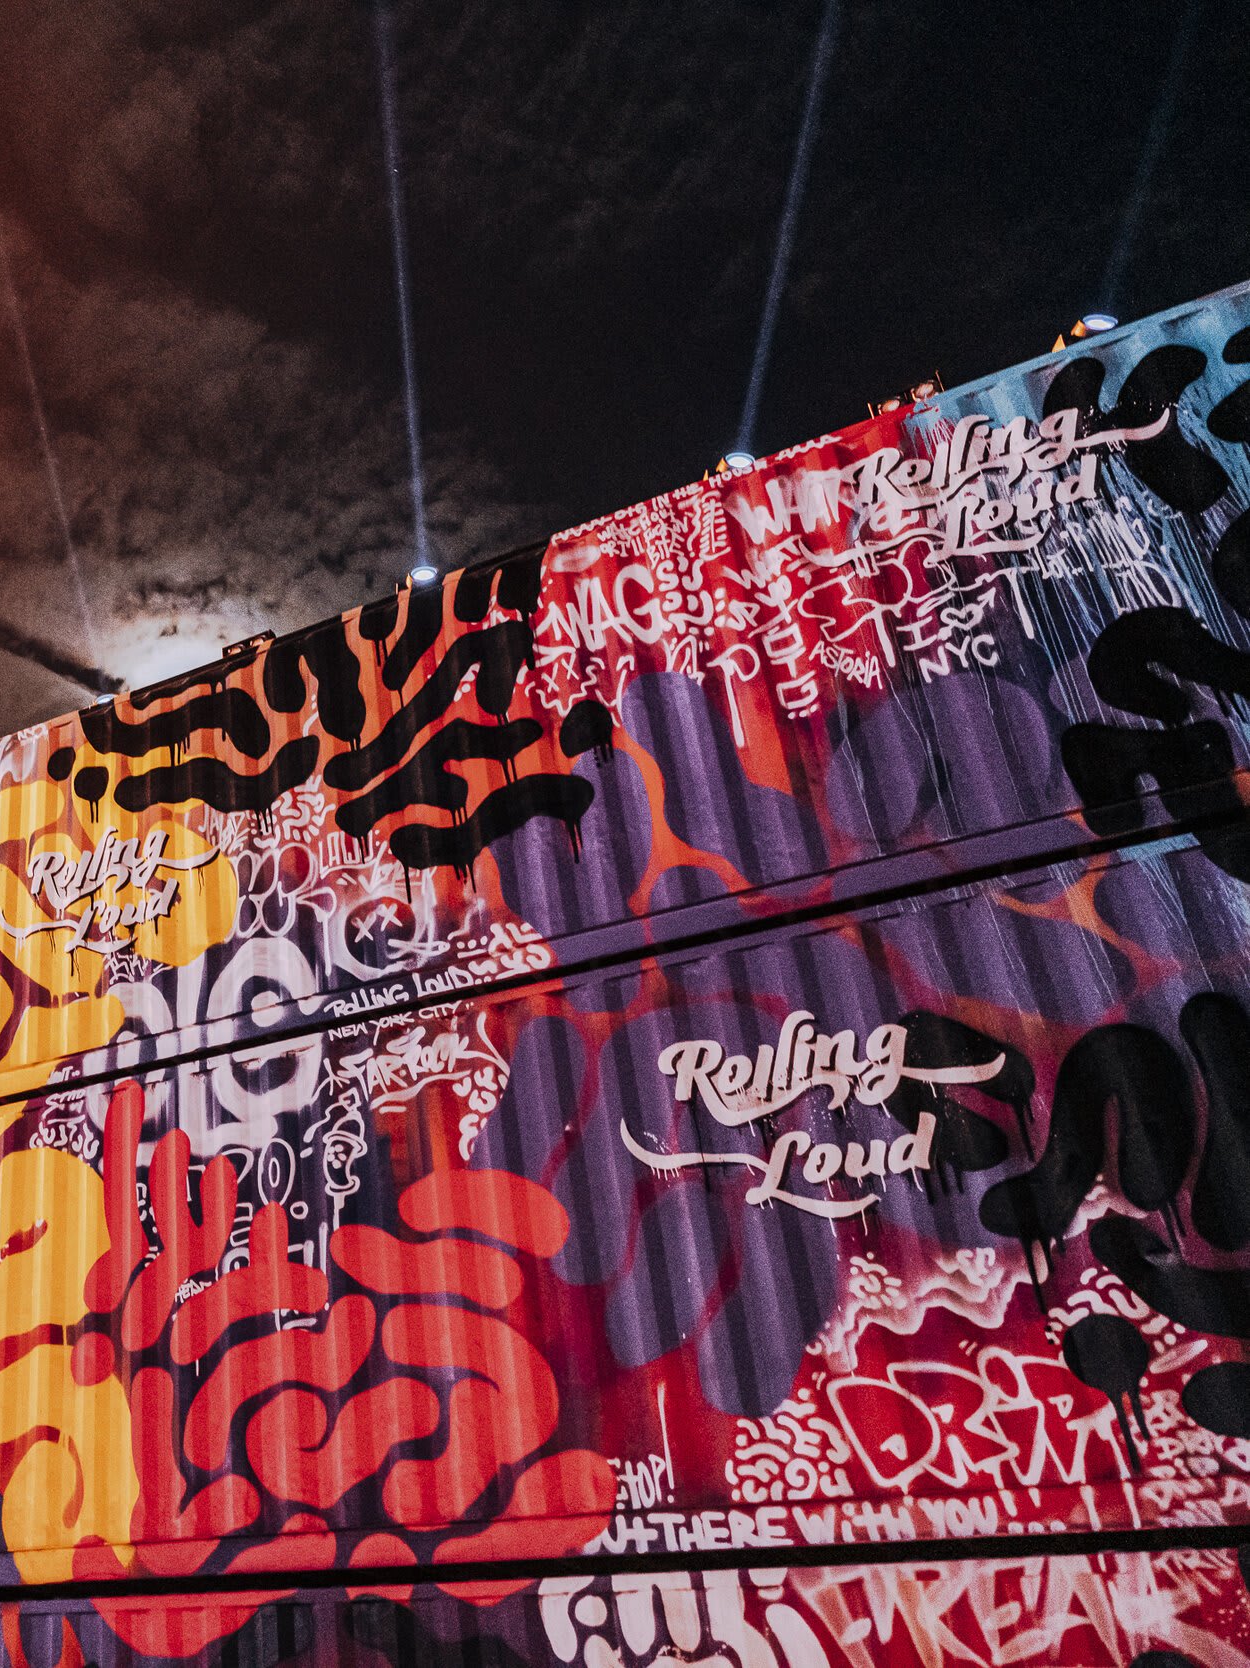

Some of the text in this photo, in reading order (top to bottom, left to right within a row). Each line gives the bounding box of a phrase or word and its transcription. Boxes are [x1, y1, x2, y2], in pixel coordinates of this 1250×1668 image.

[852, 408, 1170, 512] Rolling
[799, 453, 1098, 567] Loud
[808, 641, 884, 691] ASTORIA
[920, 635, 1000, 684] NYC
[27, 826, 220, 910] Rolling
[0, 878, 180, 954] Loud
[323, 965, 476, 1018] ROLLING LOUD
[328, 1023, 368, 1042] NEW
[371, 1012, 415, 1046] YORK
[659, 1011, 1005, 1127] Rolling
[620, 1112, 936, 1219] Loud
[647, 1506, 794, 1552] THERE
[793, 1498, 916, 1546] WITH
